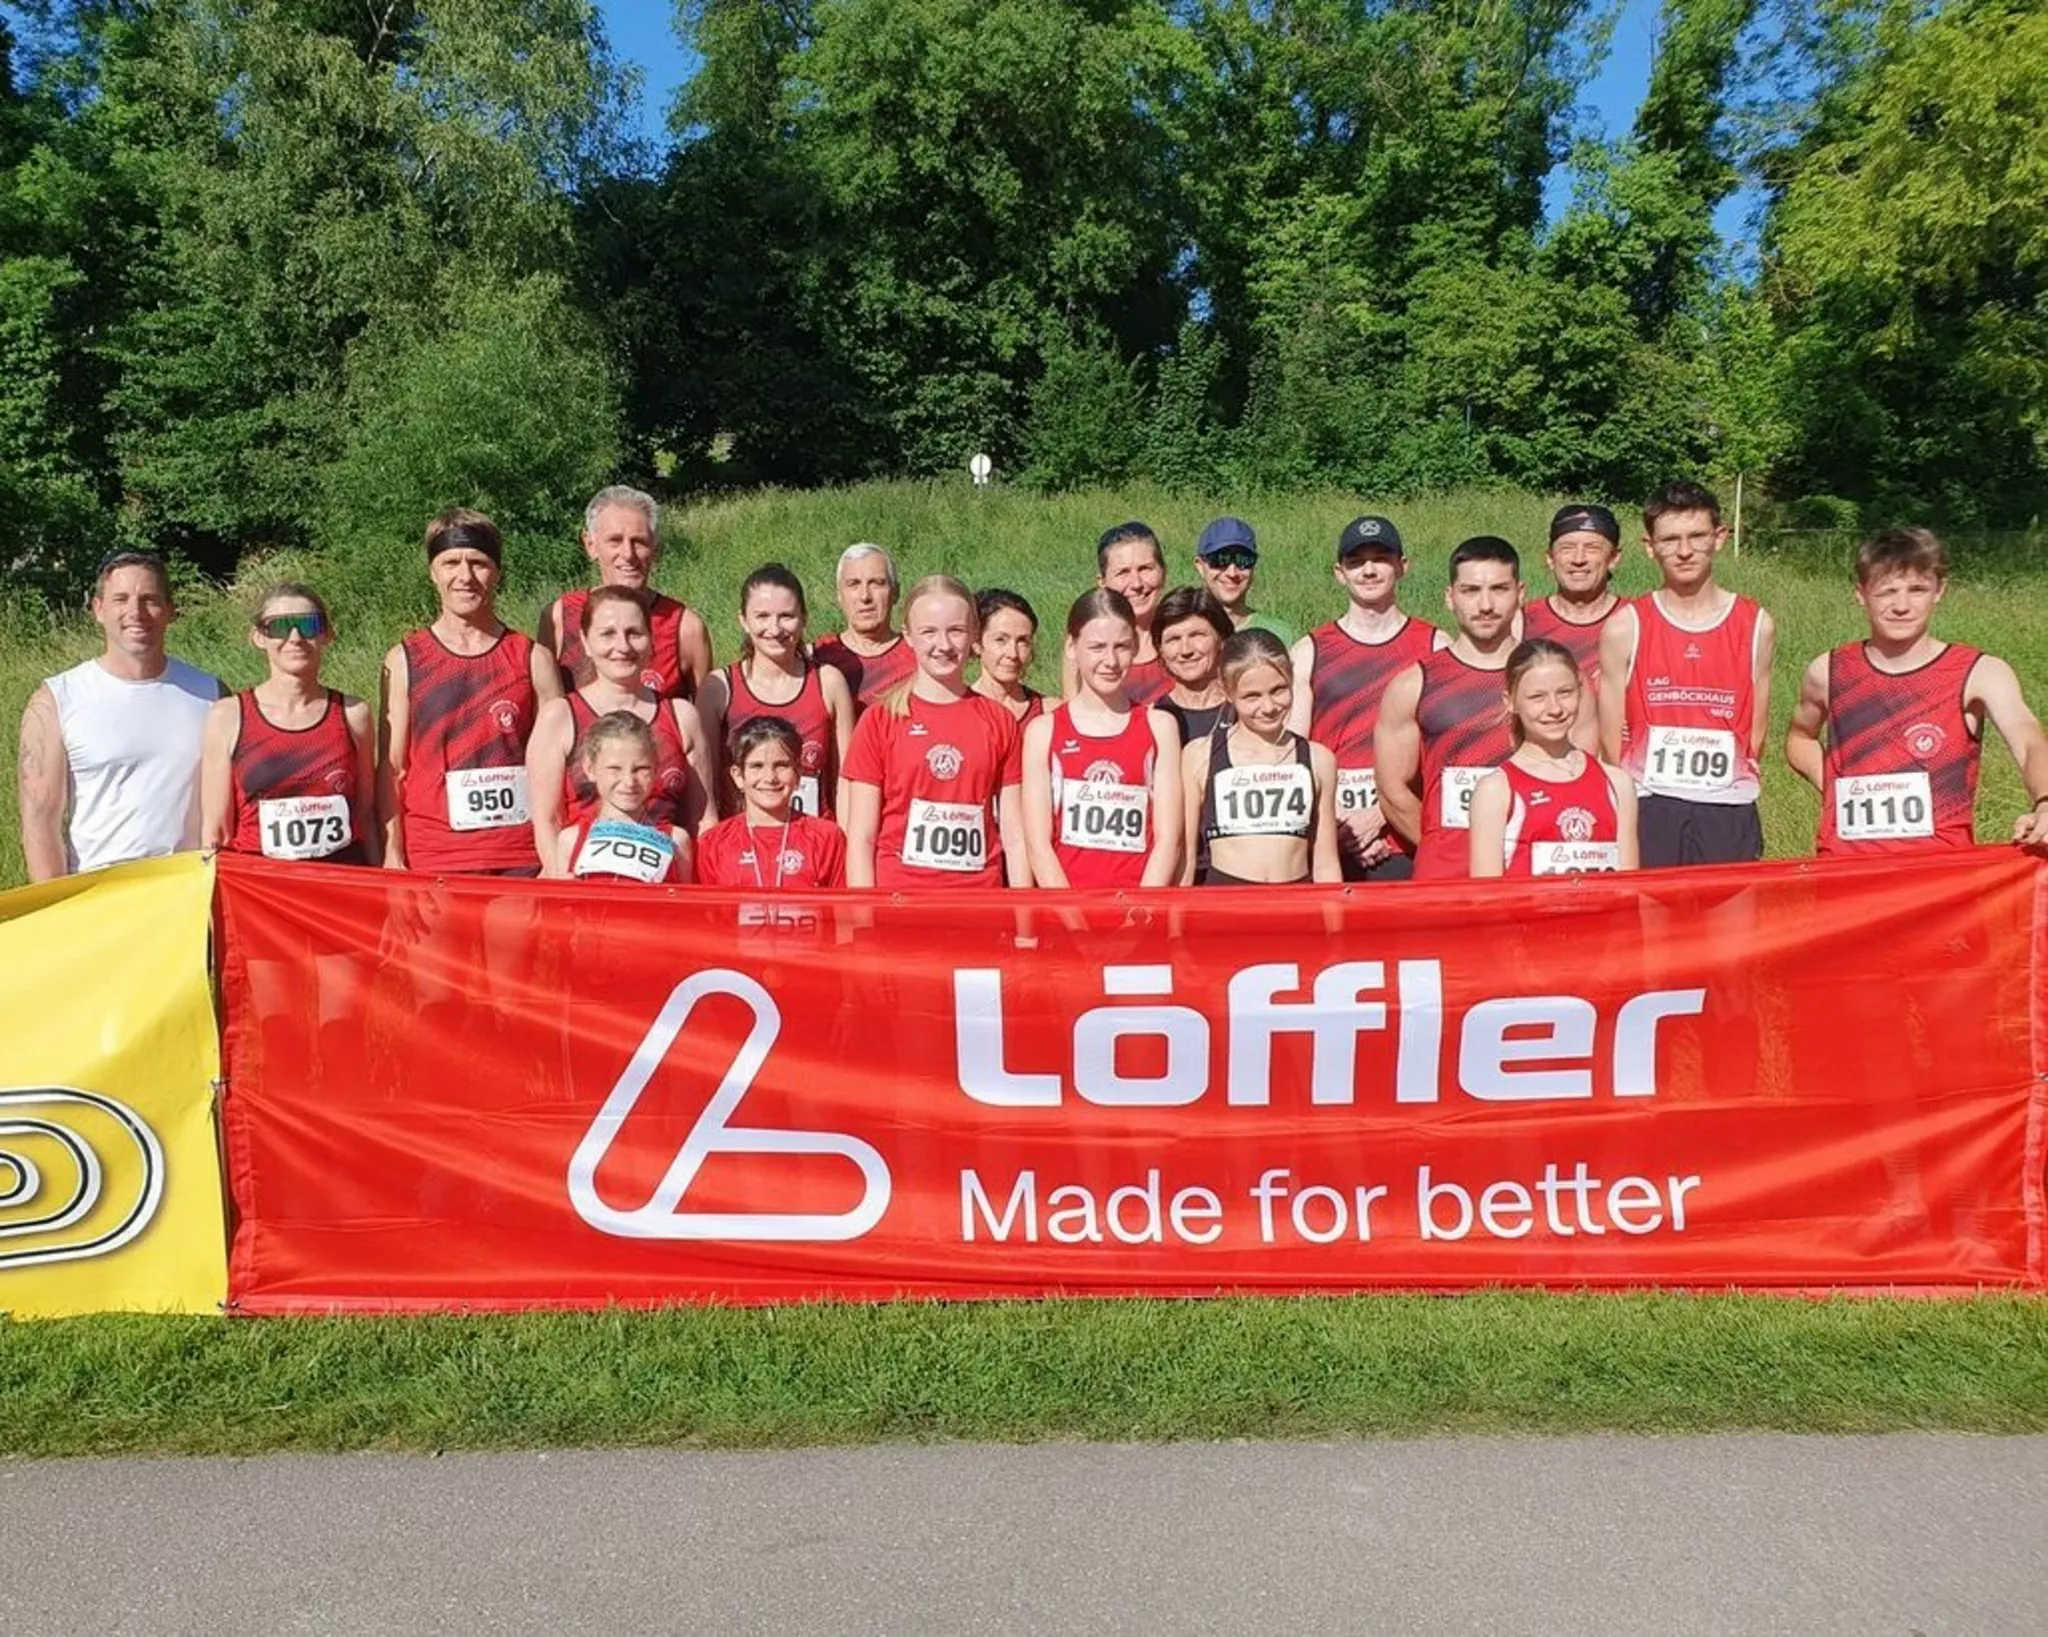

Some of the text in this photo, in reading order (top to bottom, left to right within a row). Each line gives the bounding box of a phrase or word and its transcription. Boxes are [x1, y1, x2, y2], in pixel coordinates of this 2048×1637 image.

[1653, 748, 1729, 779] 1109
[467, 788, 514, 812] 950
[1223, 787, 1307, 820] 1074
[1842, 796, 1925, 827] 1110
[267, 816, 345, 848] 1073
[1068, 803, 1143, 838] 1049
[590, 840, 662, 869] 708
[912, 824, 982, 857] 1090
[953, 959, 1706, 1107] Löffler
[961, 1165, 1701, 1244] Made for better
